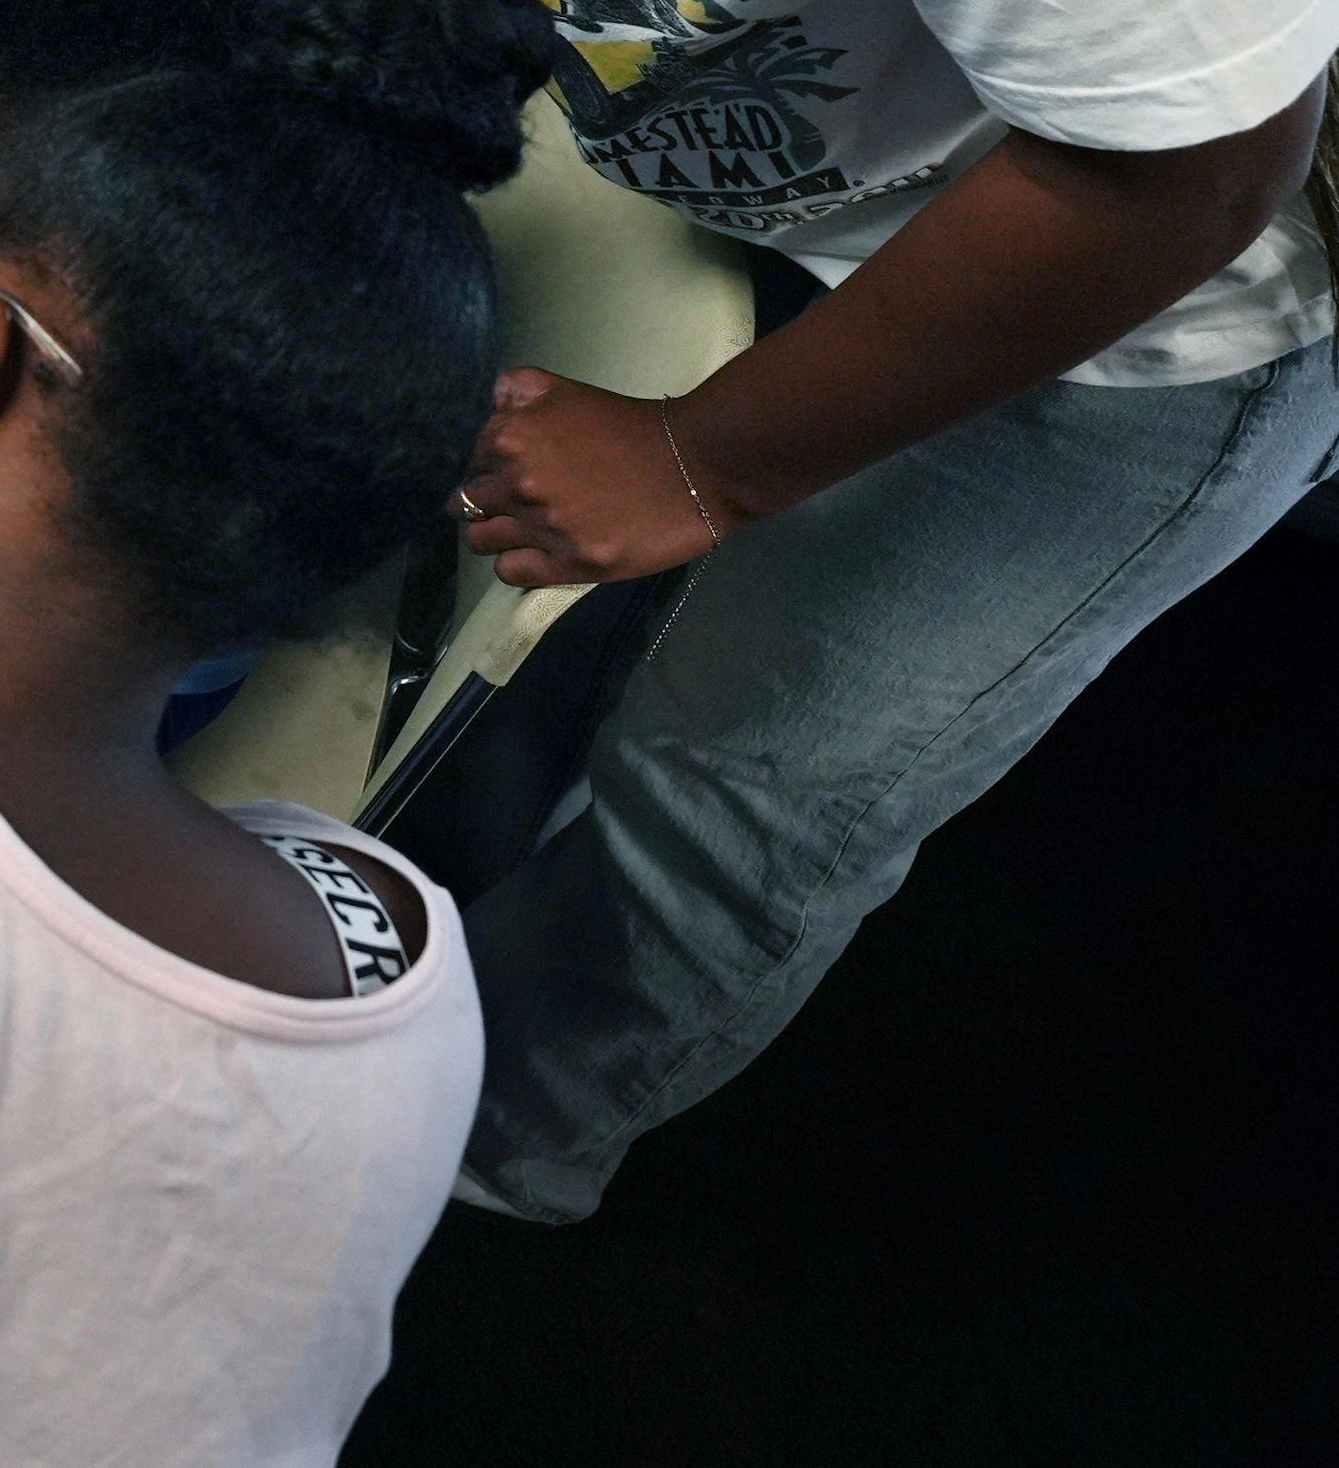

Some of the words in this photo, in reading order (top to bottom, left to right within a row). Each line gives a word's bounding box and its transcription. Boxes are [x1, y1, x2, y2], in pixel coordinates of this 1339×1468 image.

[588, 103, 785, 166] MESTEAD
[615, 150, 799, 190] IAMI
[293, 846, 407, 985] SECR
